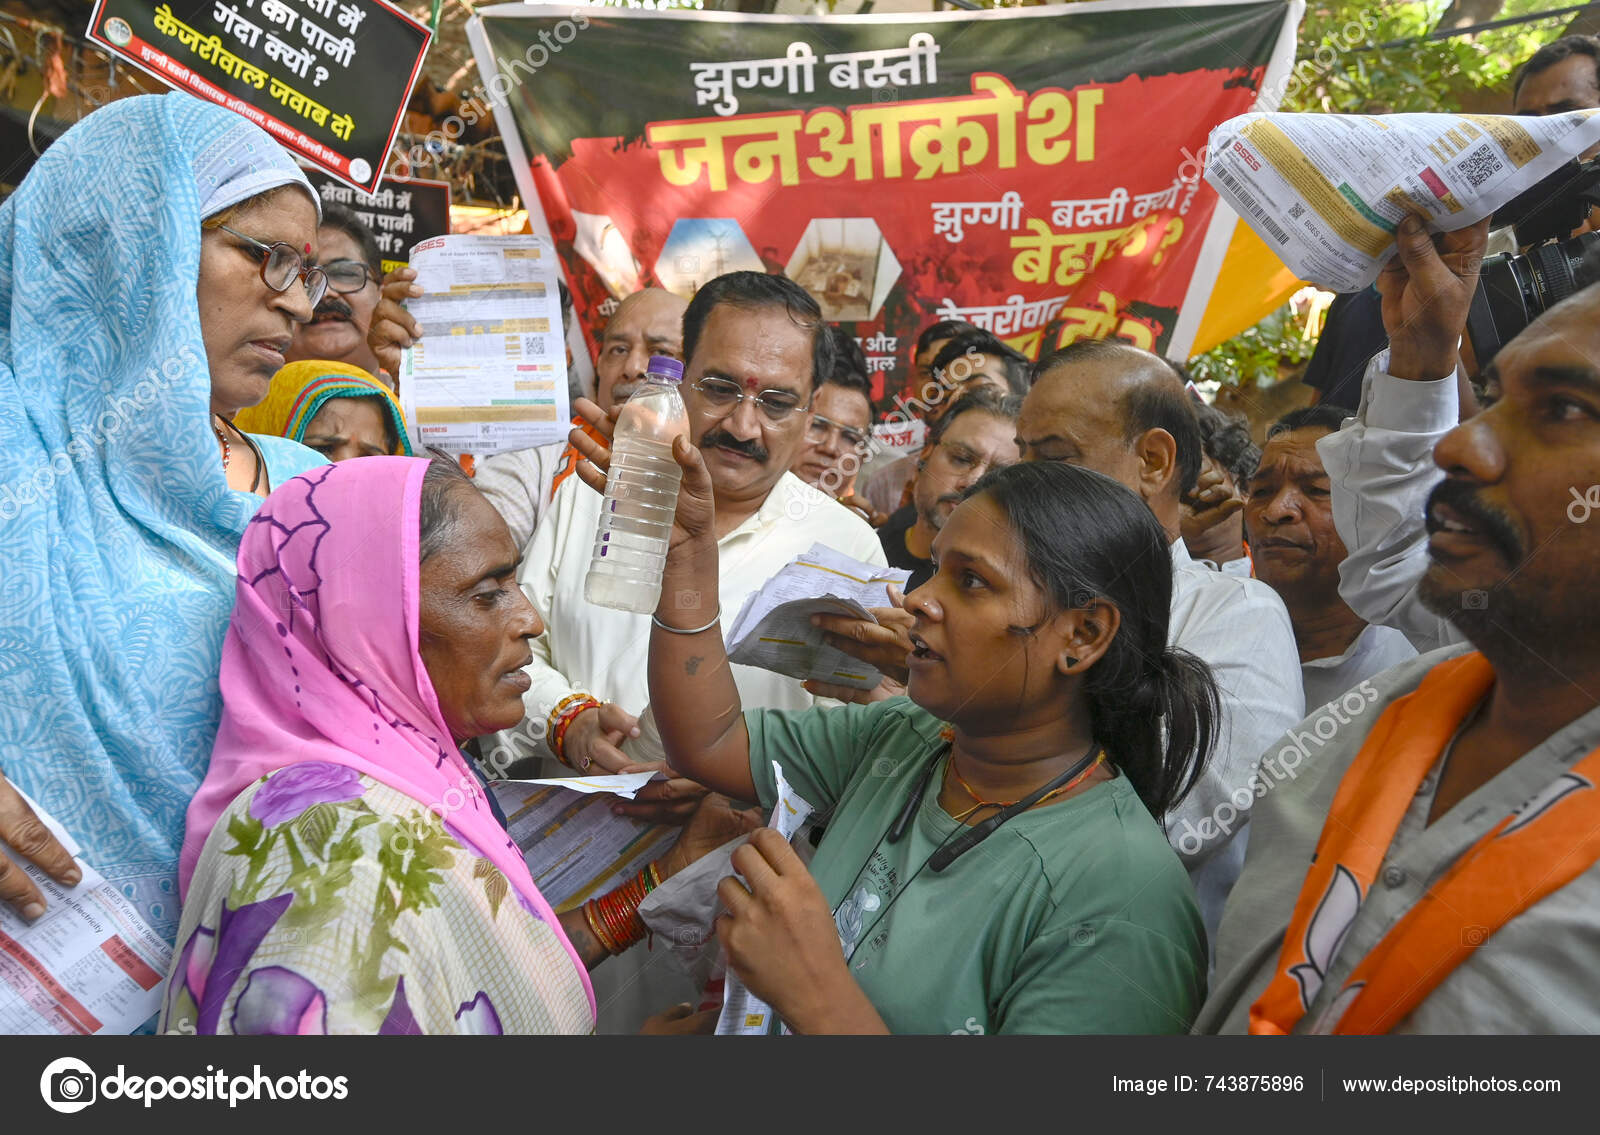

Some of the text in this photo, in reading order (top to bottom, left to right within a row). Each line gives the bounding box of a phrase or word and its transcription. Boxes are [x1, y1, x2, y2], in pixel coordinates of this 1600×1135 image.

[213, 1, 263, 48] गंदा
[264, 33, 317, 79] क्यों
[301, 17, 356, 68] पानी
[337, 4, 366, 35] में
[153, 3, 355, 141] केजरीवाल जवाब दो
[690, 33, 941, 117] झुग्गी बस्ती
[650, 76, 1104, 191] जनआक्रोश
[1233, 141, 1262, 172] BSES
[376, 213, 414, 233] पानी
[931, 191, 1024, 243] झुग्गी
[1051, 187, 1129, 228] बस्ती
[866, 331, 897, 352] और
